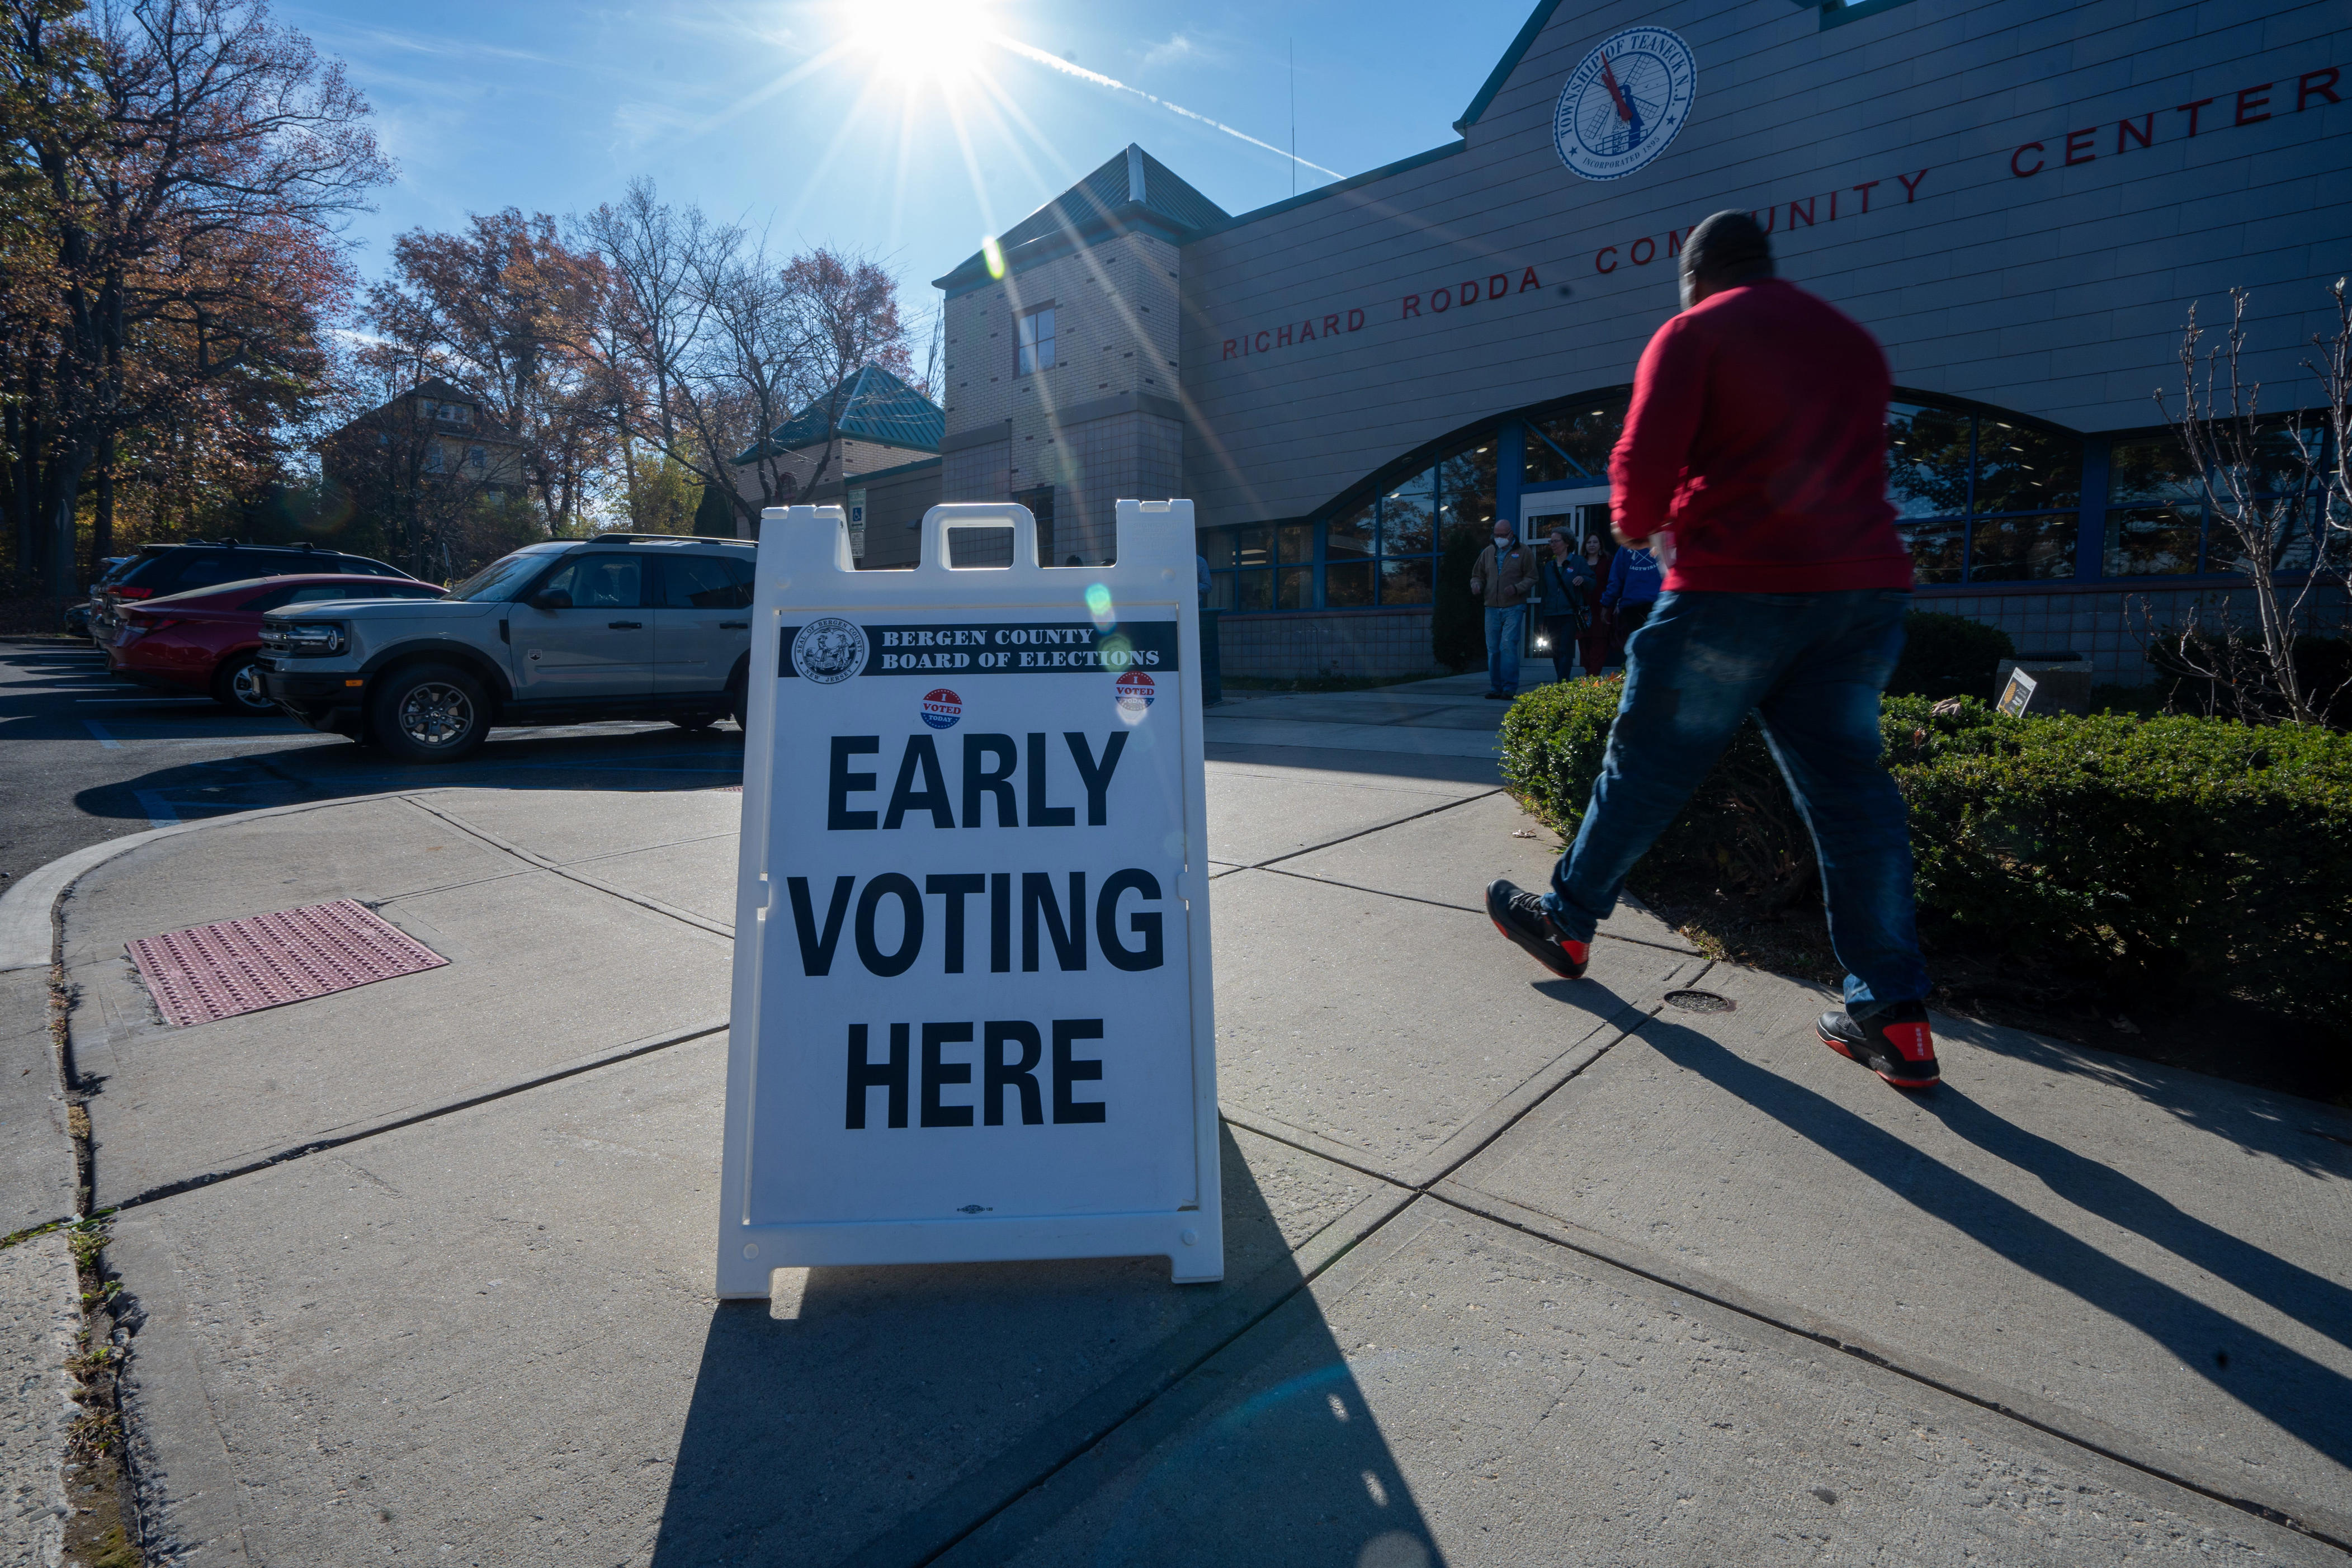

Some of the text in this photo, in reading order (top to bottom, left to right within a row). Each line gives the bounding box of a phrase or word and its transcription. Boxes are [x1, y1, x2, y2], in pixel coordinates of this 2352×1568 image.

[1560, 55, 1599, 139] TOWNSHIP
[1605, 39, 1624, 58] OF
[1631, 35, 1687, 74] TEANECK
[1583, 137, 1660, 169] INCORPORATED 1895
[1222, 66, 2342, 361] RICHARD RODDA COMUNITY CENTER
[797, 620, 863, 653] SEAL OF BERGEN COUNTY
[882, 629, 1094, 646] BERGEN COUNTY
[881, 650, 1160, 669] BOARD OF ELECTIONS
[805, 669, 853, 682] NEW JERSEY
[1134, 676, 1138, 684] I
[941, 693, 947, 701] I
[1116, 687, 1154, 696] VOTED
[923, 703, 961, 715] VOTED
[827, 731, 1130, 831] EARLY
[786, 867, 1164, 977] VOTING
[845, 1018, 1107, 1130] HERE
